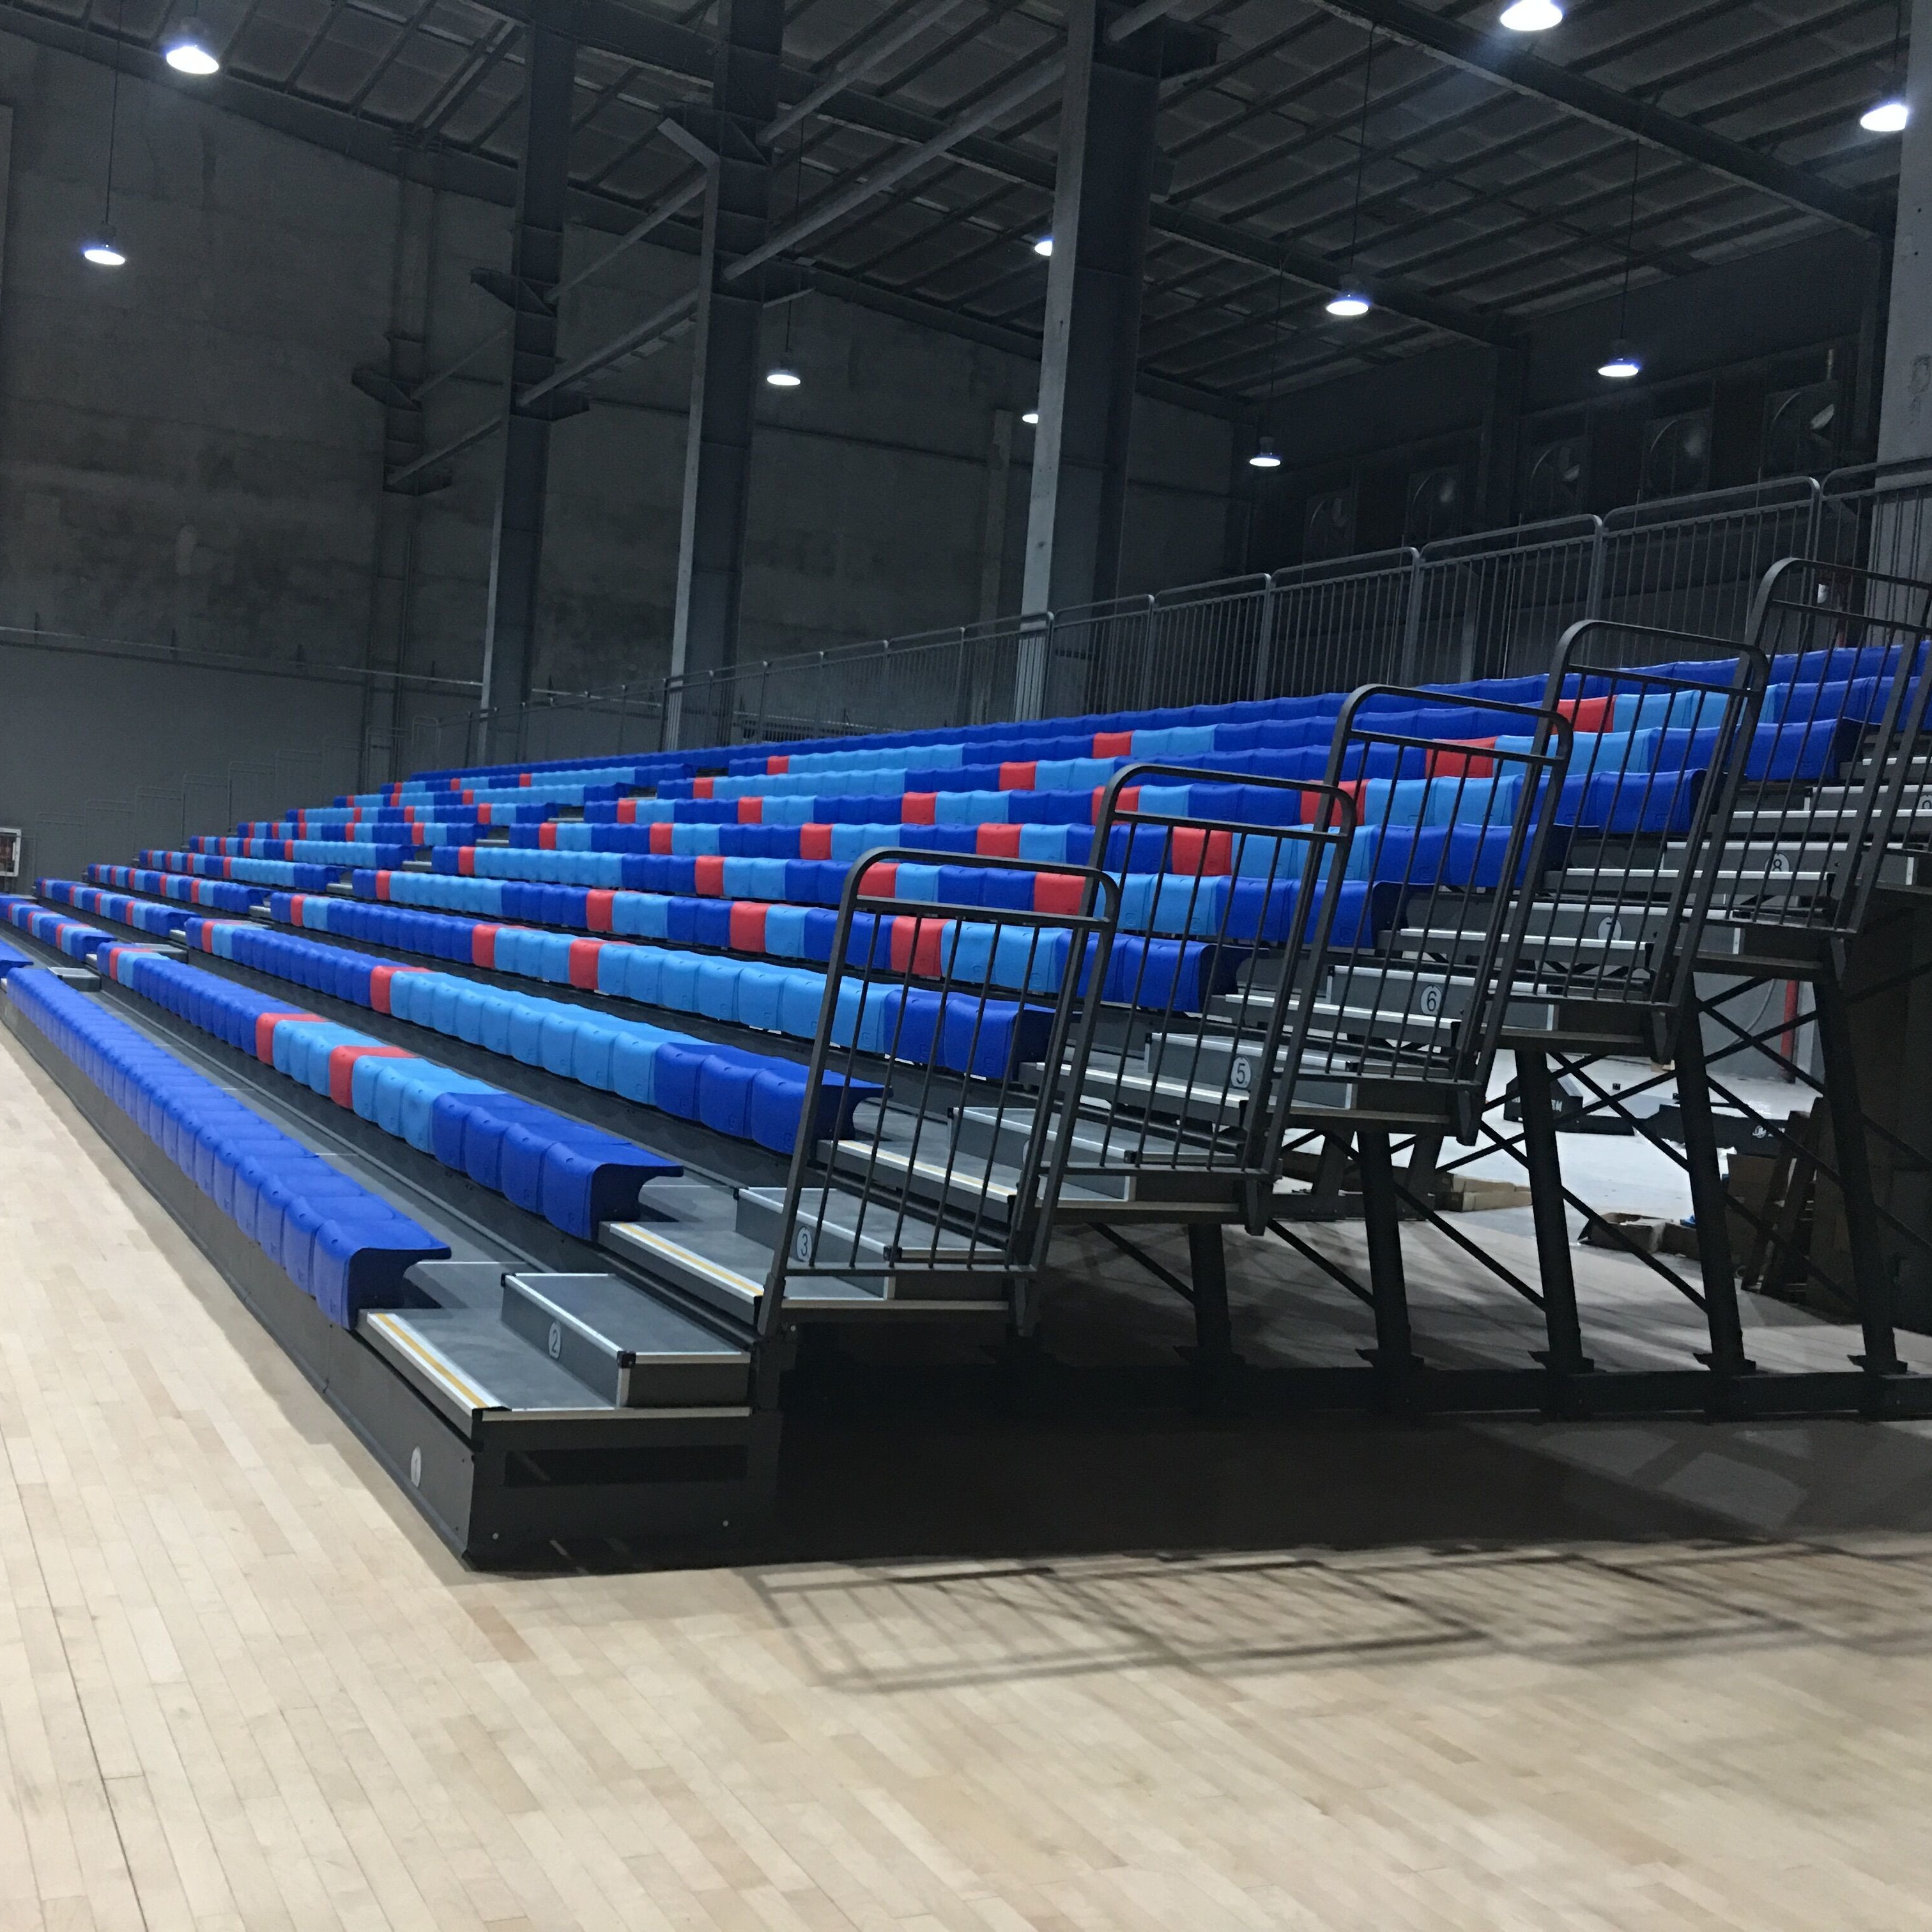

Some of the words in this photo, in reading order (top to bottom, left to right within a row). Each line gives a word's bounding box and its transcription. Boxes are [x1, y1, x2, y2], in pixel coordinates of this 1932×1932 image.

[1427, 990, 1437, 1012] 6
[1236, 1062, 1245, 1084] 5
[801, 1233, 808, 1257] 3
[551, 1330, 558, 1353] 2
